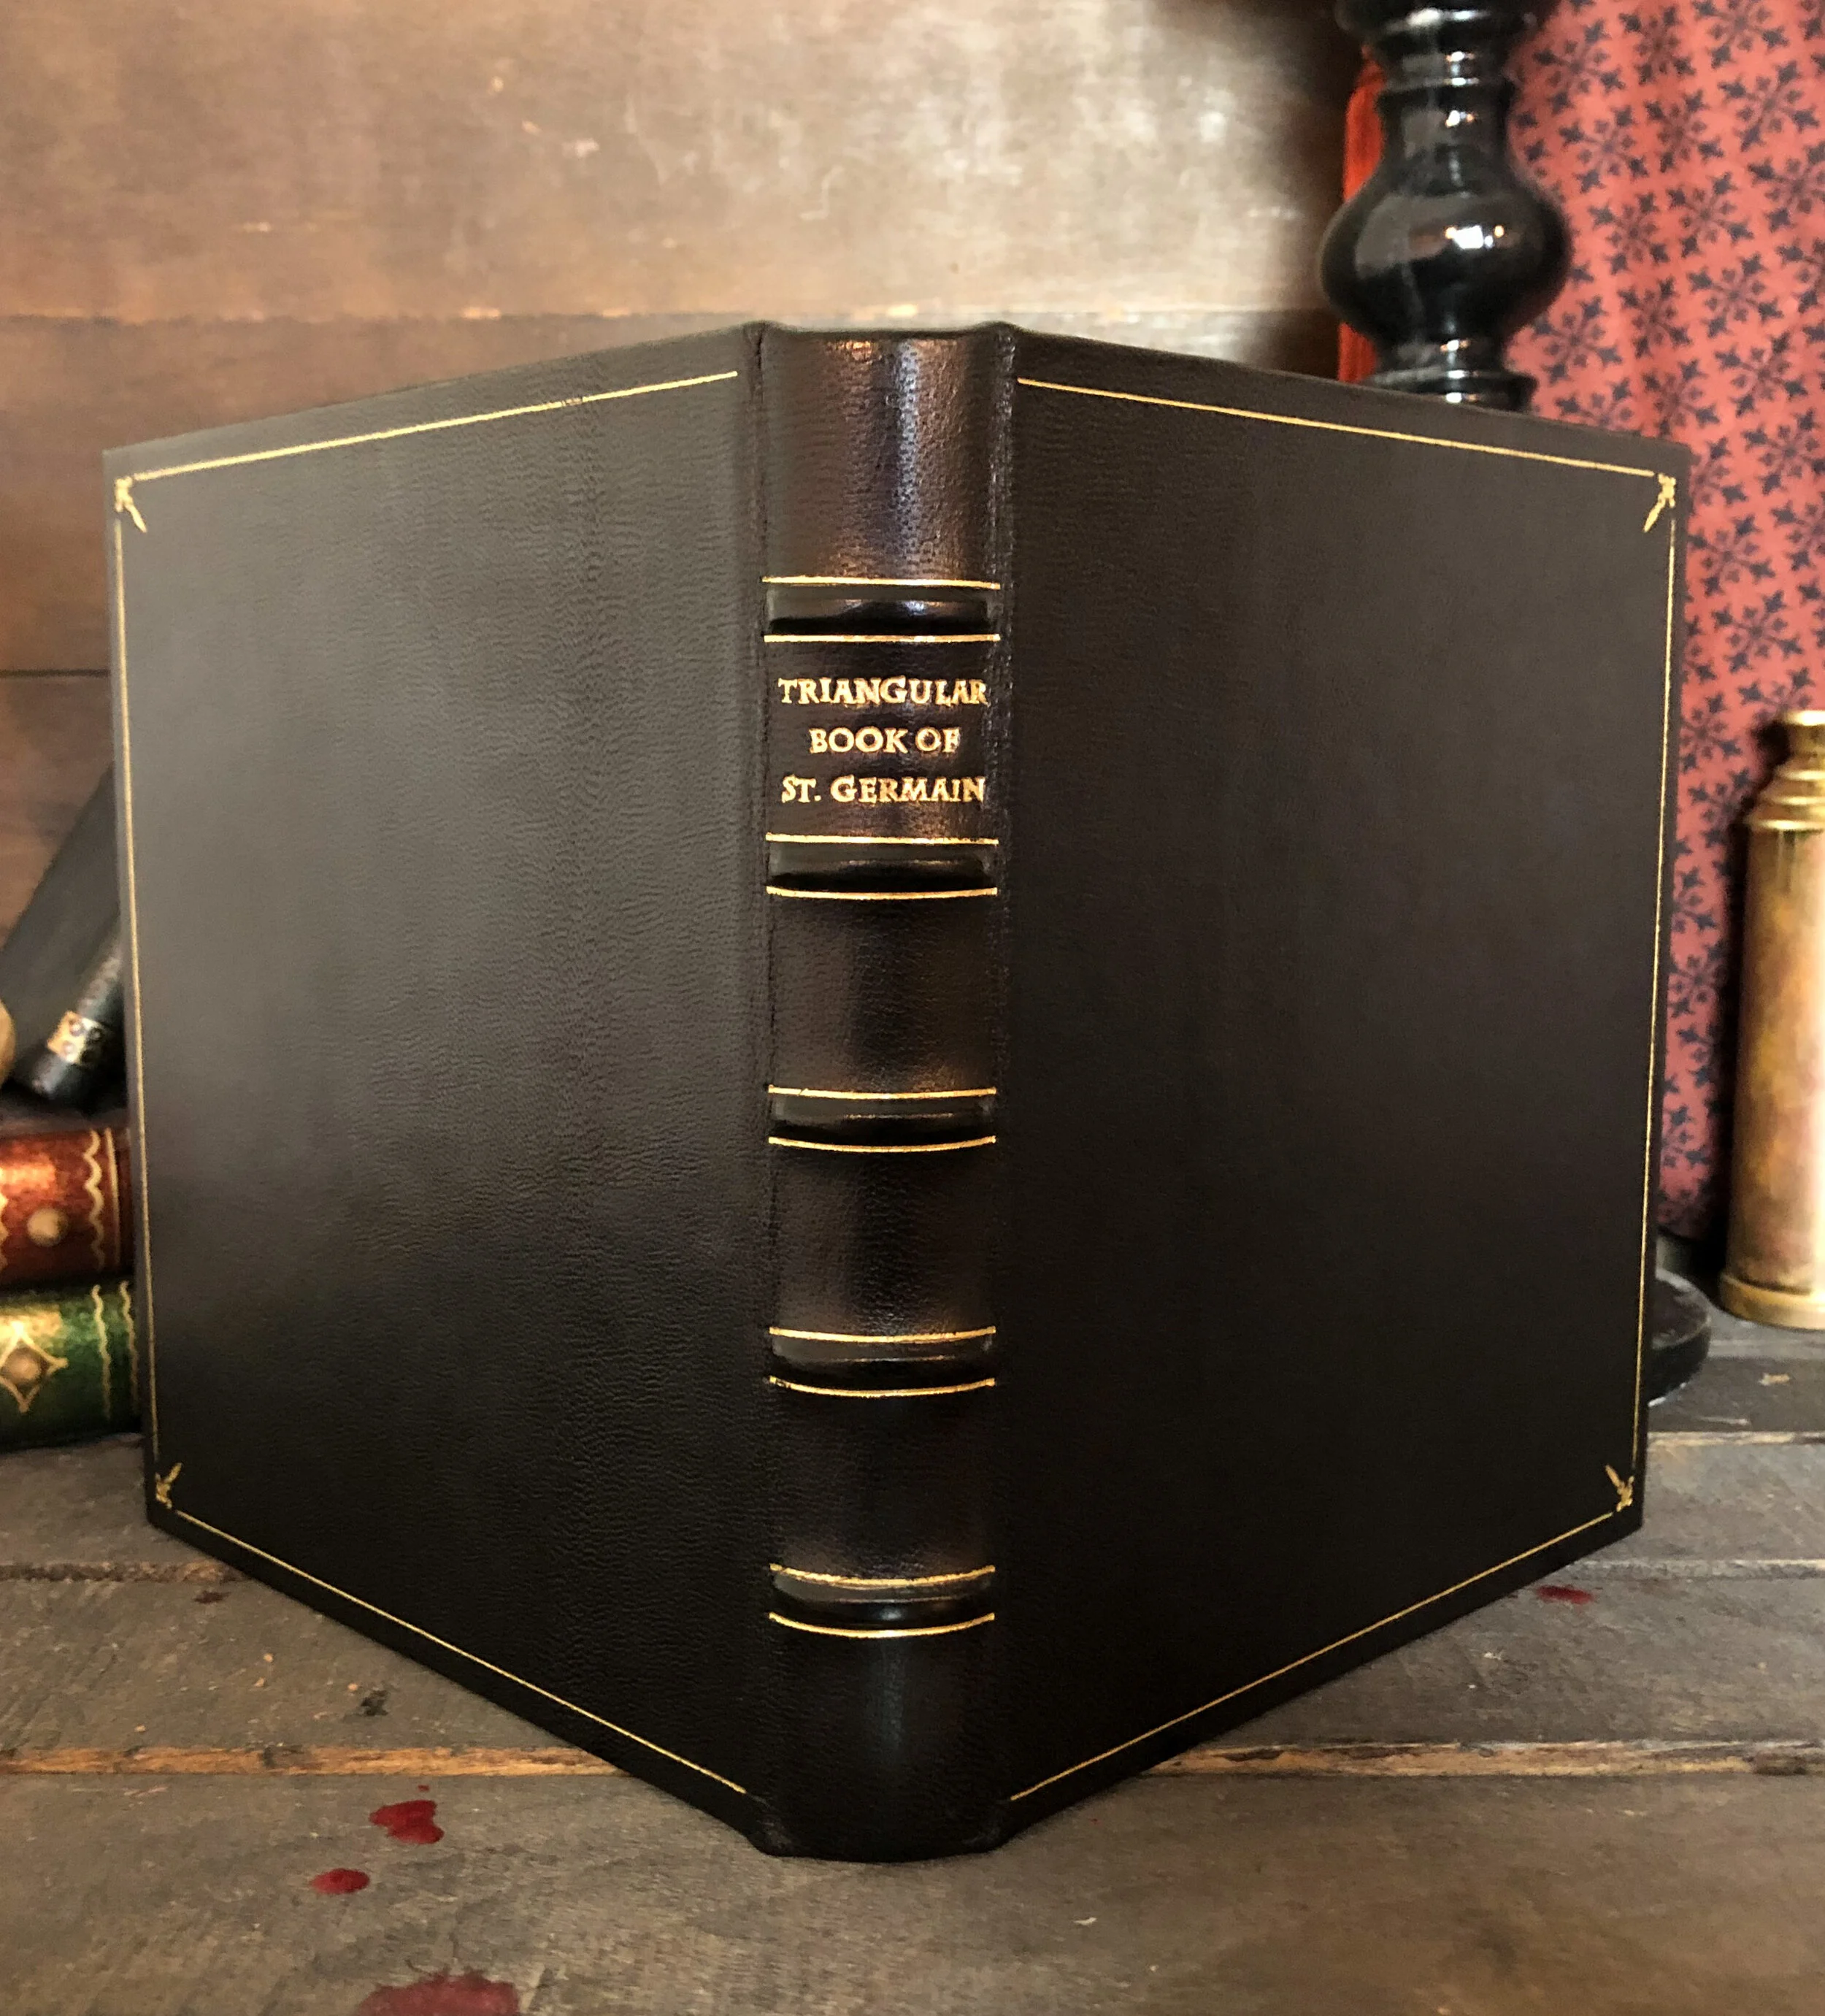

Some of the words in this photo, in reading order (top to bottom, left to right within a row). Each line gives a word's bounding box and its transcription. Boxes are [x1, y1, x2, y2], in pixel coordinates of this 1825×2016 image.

[778, 675, 988, 706] TRIANGULAR
[808, 726, 909, 754] BOOK
[915, 726, 961, 754] OF
[781, 774, 821, 803] ST.
[830, 774, 986, 804] GERMAIN
